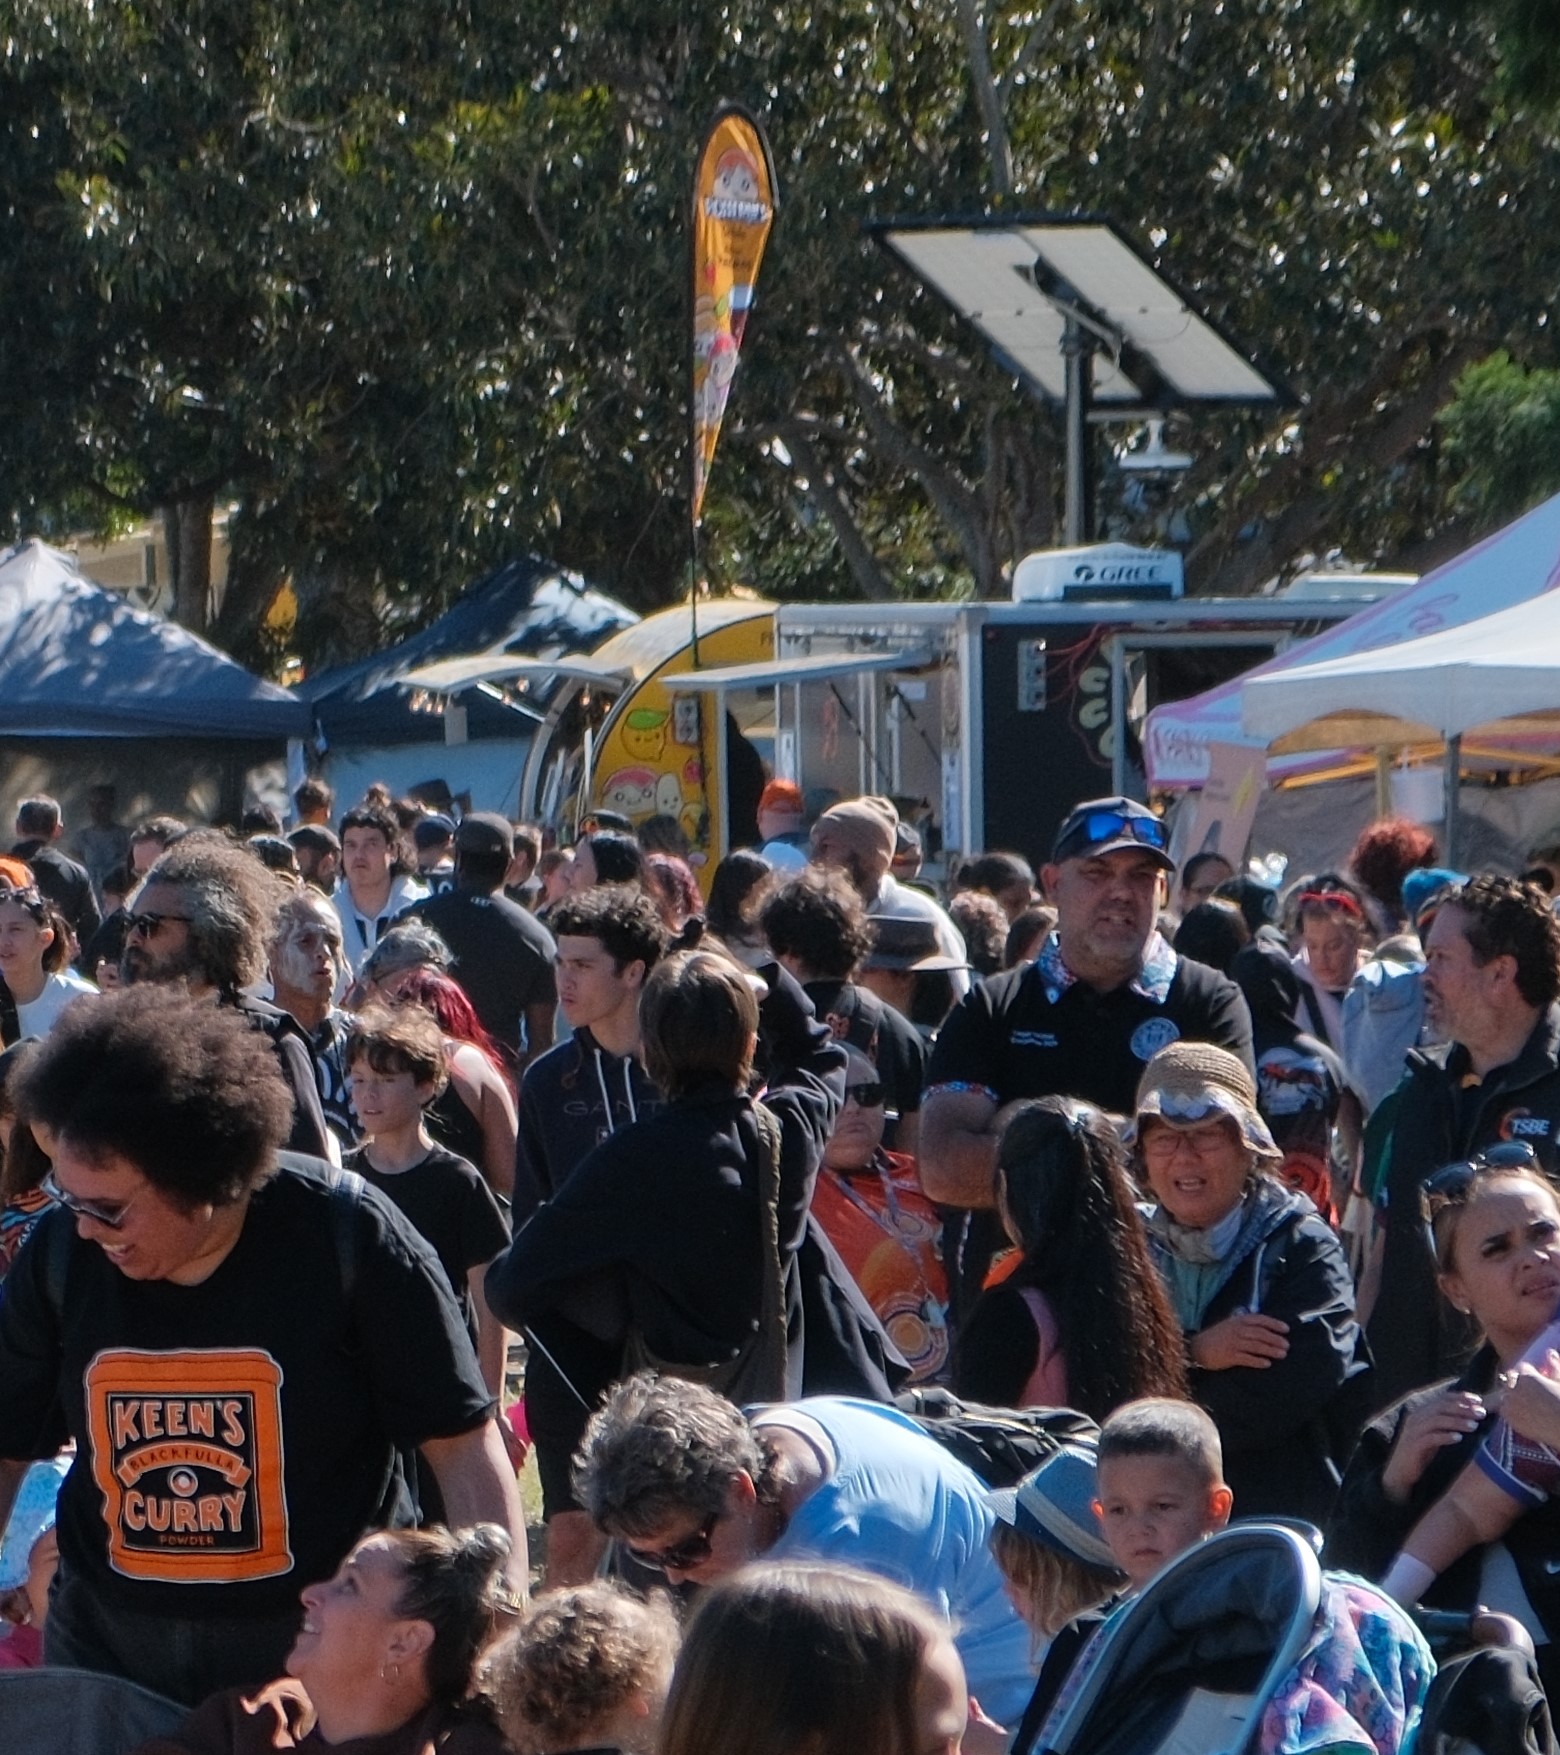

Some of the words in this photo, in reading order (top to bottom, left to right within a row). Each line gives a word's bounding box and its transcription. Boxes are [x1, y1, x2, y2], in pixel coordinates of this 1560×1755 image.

[1099, 565, 1162, 583] GREE
[113, 1400, 247, 1449] KEEN'S
[129, 1446, 235, 1472] BLACKFULLA
[123, 1489, 248, 1533] CURRY
[158, 1535, 215, 1546] POWDER
